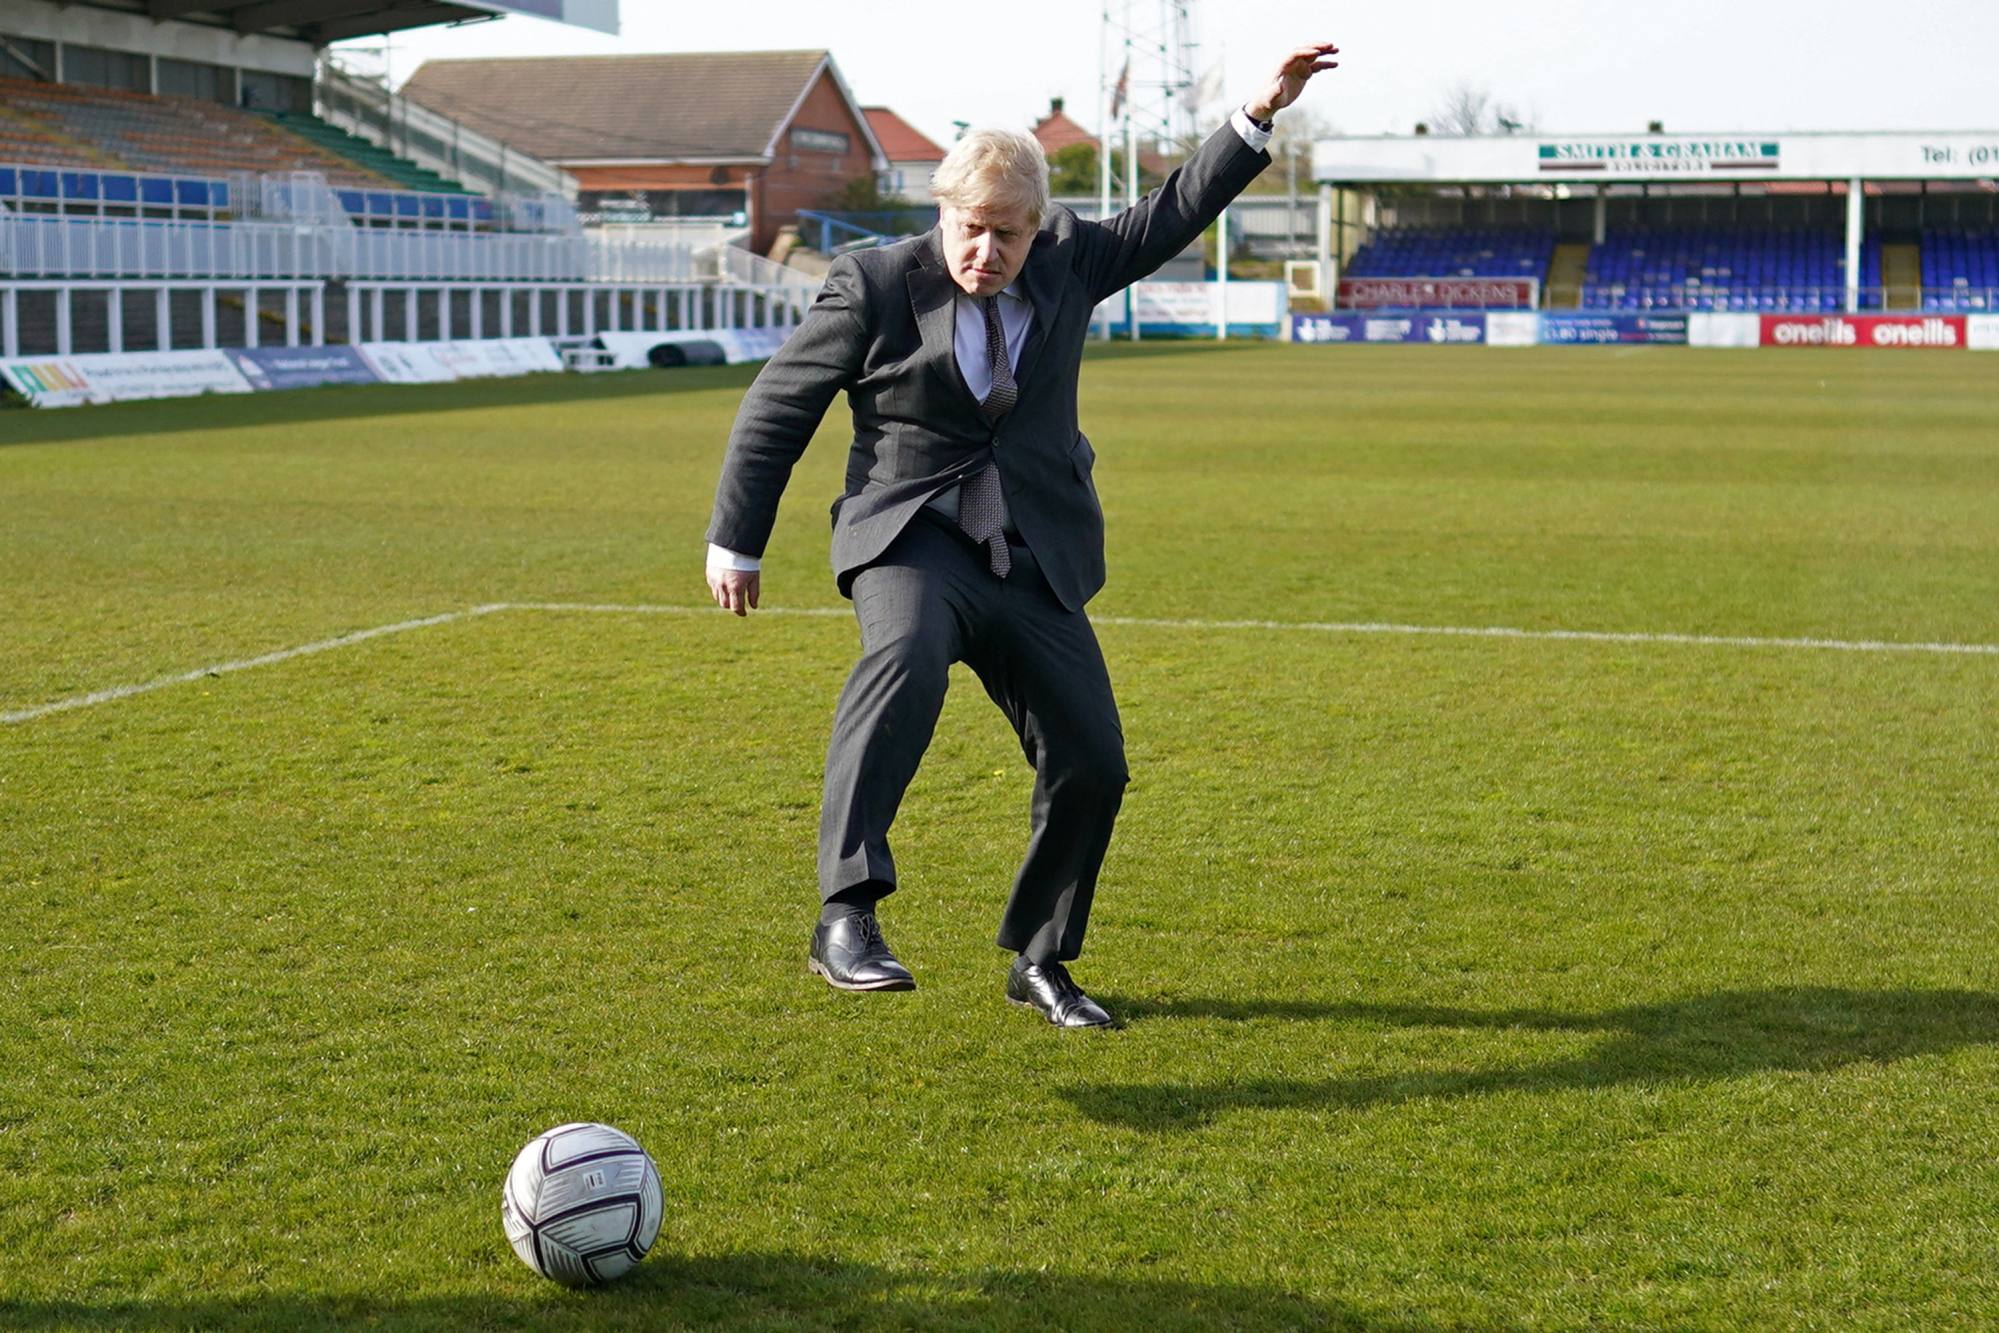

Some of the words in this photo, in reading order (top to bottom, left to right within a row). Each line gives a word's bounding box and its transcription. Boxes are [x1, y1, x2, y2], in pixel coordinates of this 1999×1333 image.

[1555, 143, 1631, 159] SMITH
[1637, 143, 1655, 159] &
[1660, 142, 1762, 158] GRAHAM
[1920, 144, 1958, 163] Tel:
[1440, 282, 1516, 299] DICKENS
